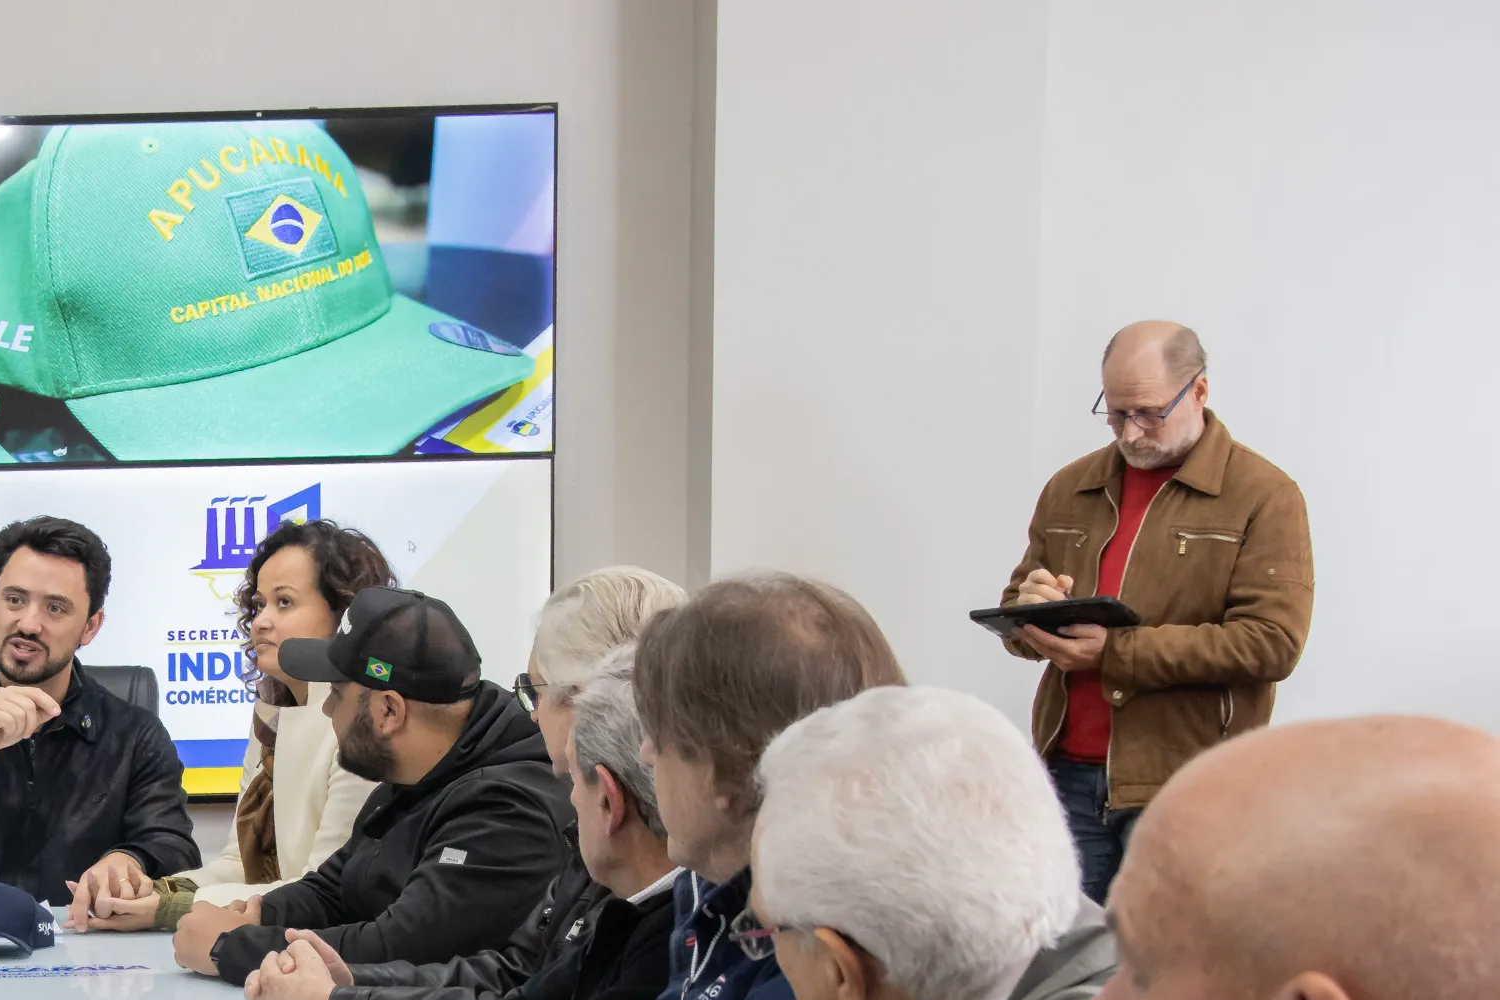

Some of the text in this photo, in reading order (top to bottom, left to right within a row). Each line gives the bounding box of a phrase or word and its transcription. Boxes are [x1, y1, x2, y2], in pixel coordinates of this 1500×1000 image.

[148, 137, 348, 242] APUCARANA
[170, 292, 254, 324] CAPITAL
[256, 265, 338, 302] NACIONAL
[167, 629, 249, 641] SECRETA
